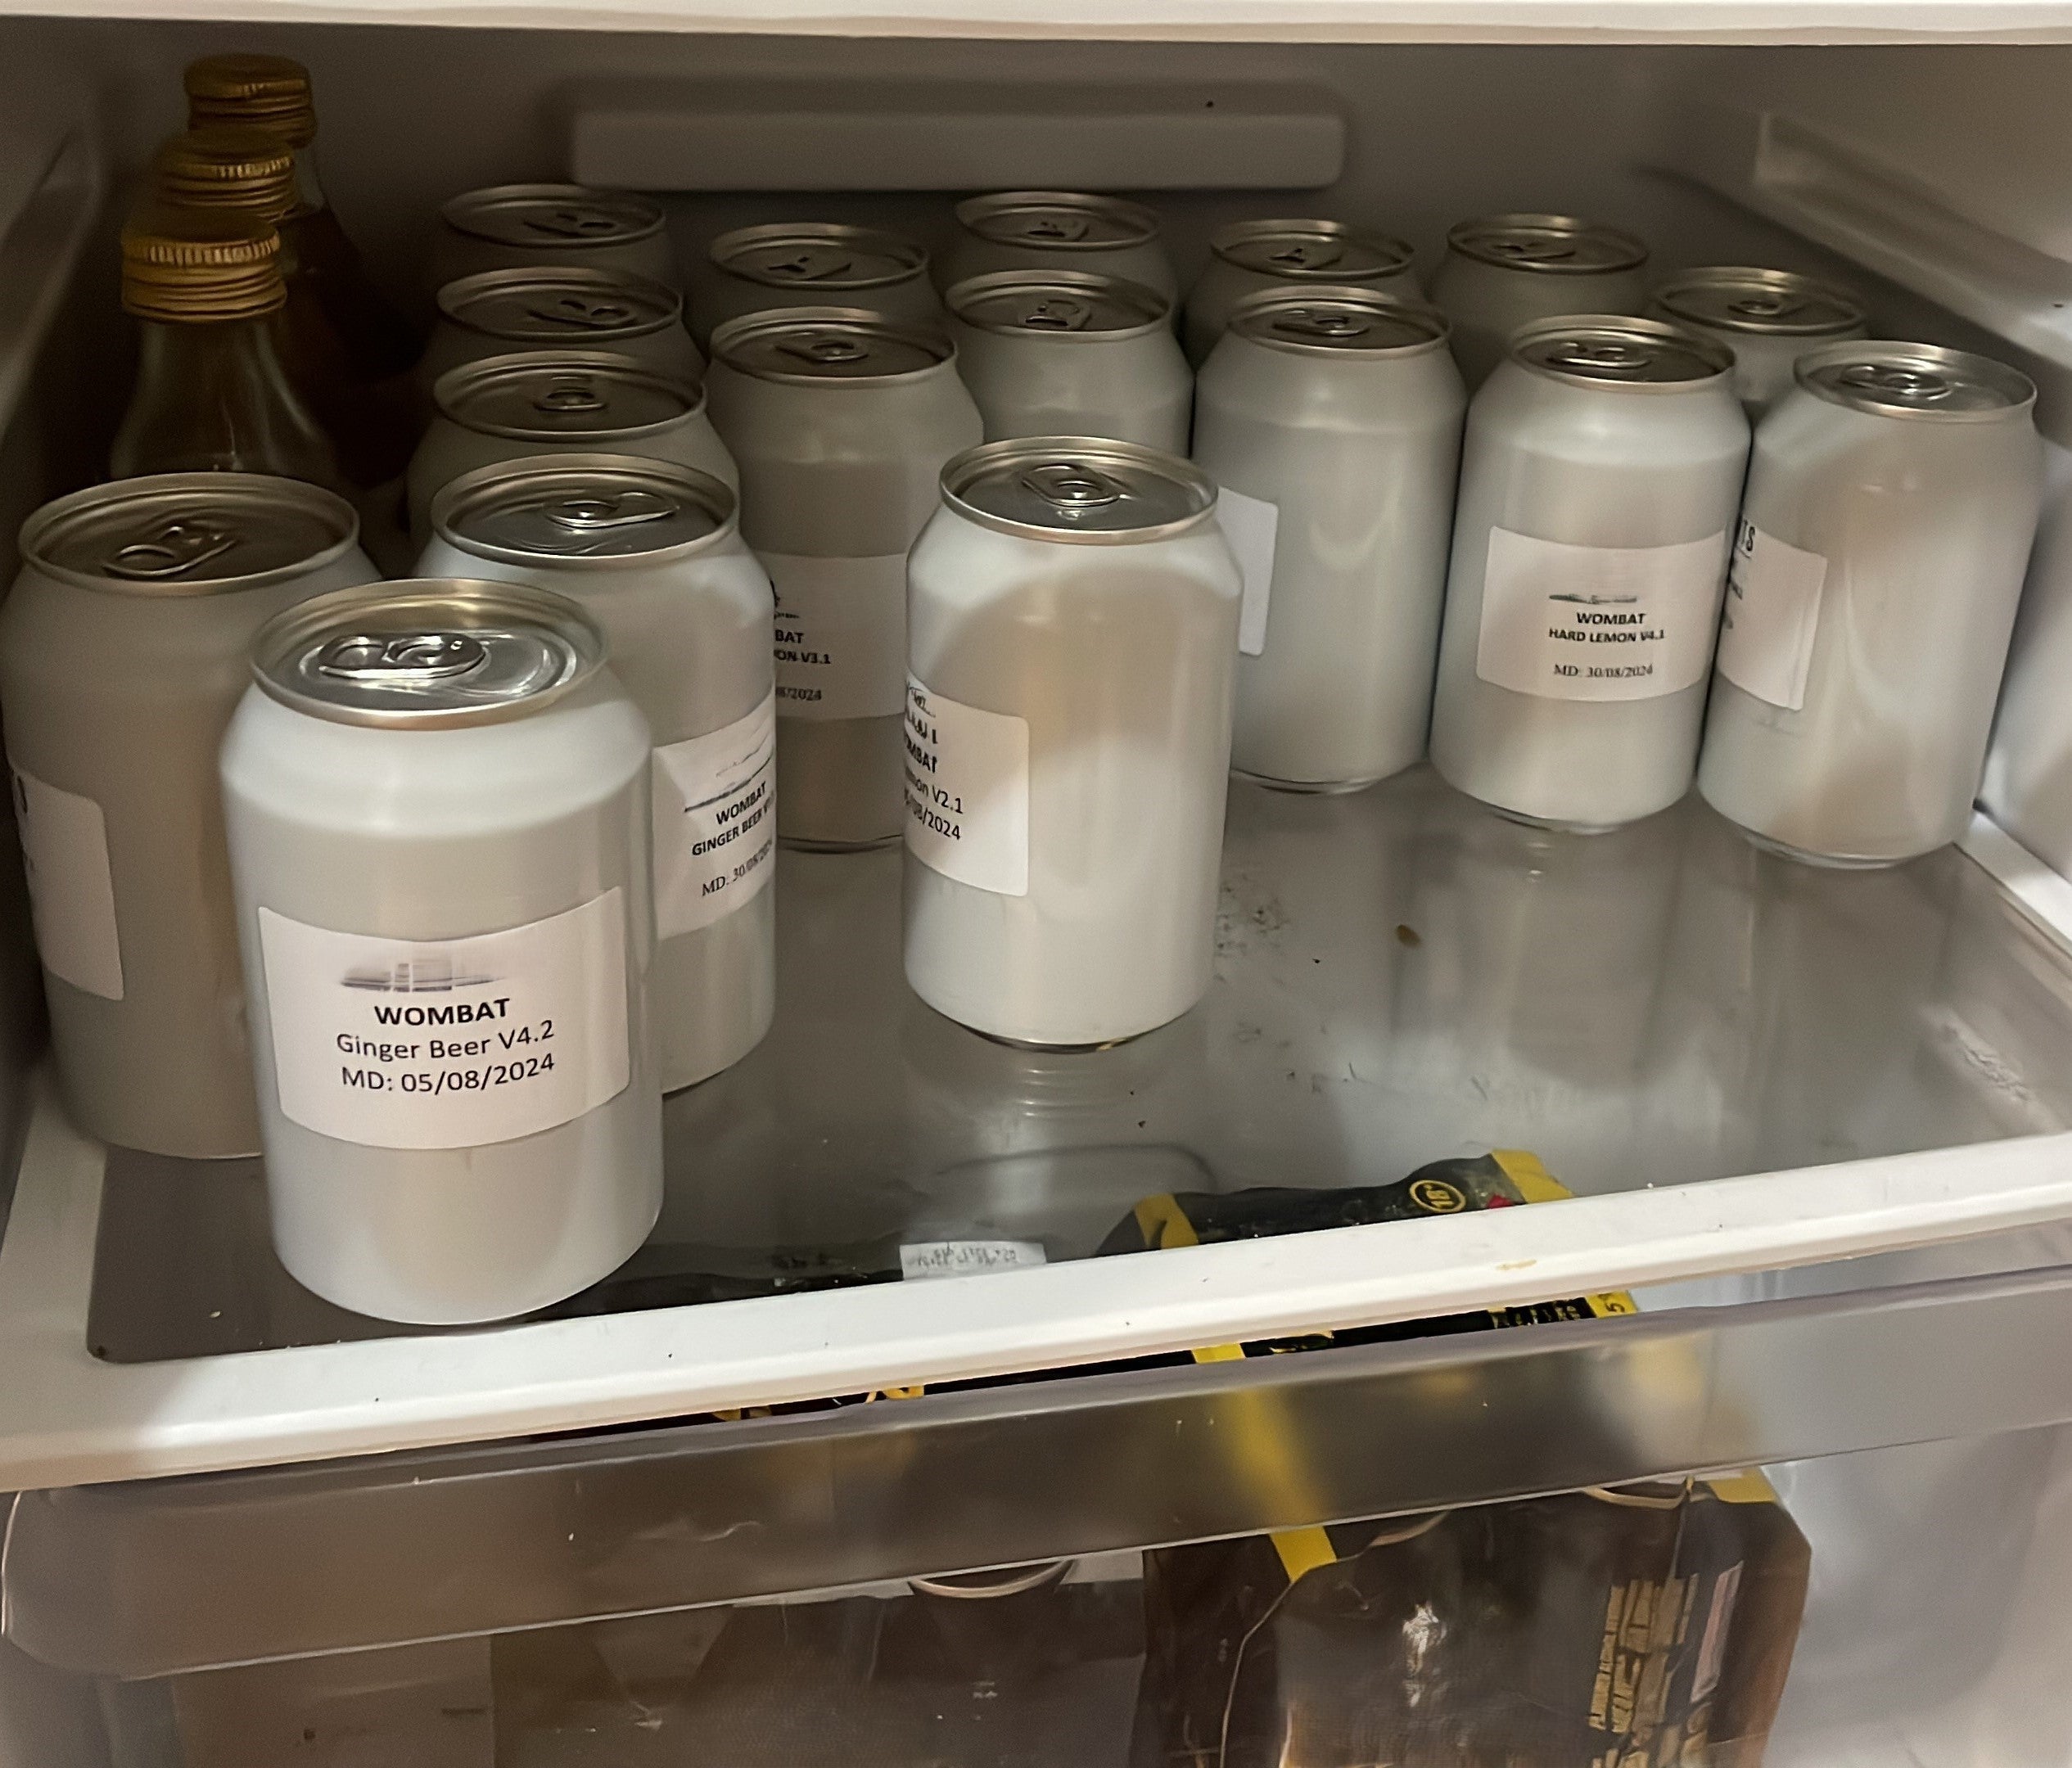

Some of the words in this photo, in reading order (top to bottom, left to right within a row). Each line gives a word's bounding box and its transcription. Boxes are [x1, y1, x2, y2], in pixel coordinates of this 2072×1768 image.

[1576, 612, 1647, 625] WOMBAT
[774, 629, 804, 643] BAT
[1549, 628, 1586, 642] HARD
[1590, 632, 1636, 643] LEMON
[716, 781, 766, 825] WOMBAT
[932, 784, 964, 814] V2.1
[692, 826, 739, 856] GINGER
[374, 998, 511, 1026] WOMBAT
[336, 1034, 421, 1062] Ginger
[431, 1038, 490, 1059] Beer
[498, 1020, 554, 1050] V4.2
[342, 1067, 393, 1092] MD:
[401, 1053, 555, 1095] 05/08/2024
